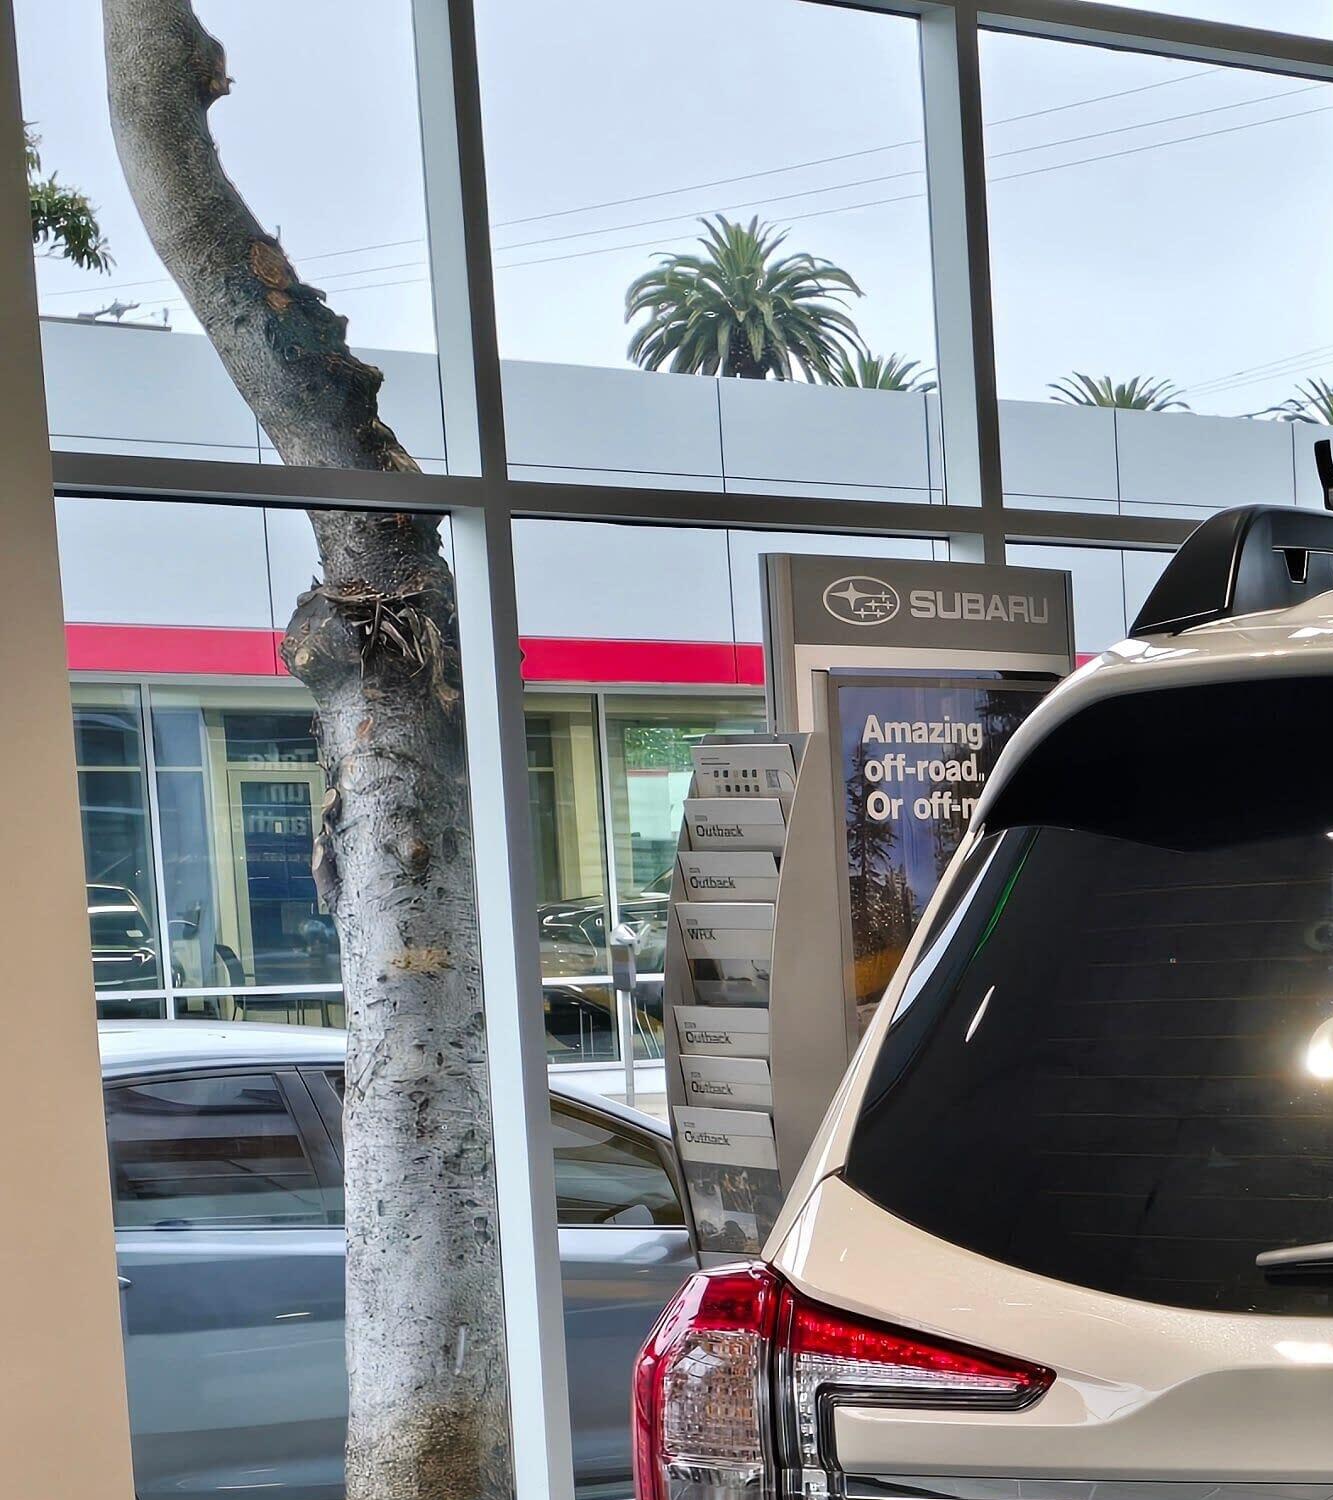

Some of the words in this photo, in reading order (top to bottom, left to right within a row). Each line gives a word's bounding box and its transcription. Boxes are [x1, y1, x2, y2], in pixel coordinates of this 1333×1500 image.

[909, 590, 1049, 624] SUBARU
[862, 714, 983, 751] Amazing
[866, 790, 904, 821] Or
[696, 825, 744, 838] Outback
[689, 876, 736, 889] Outback
